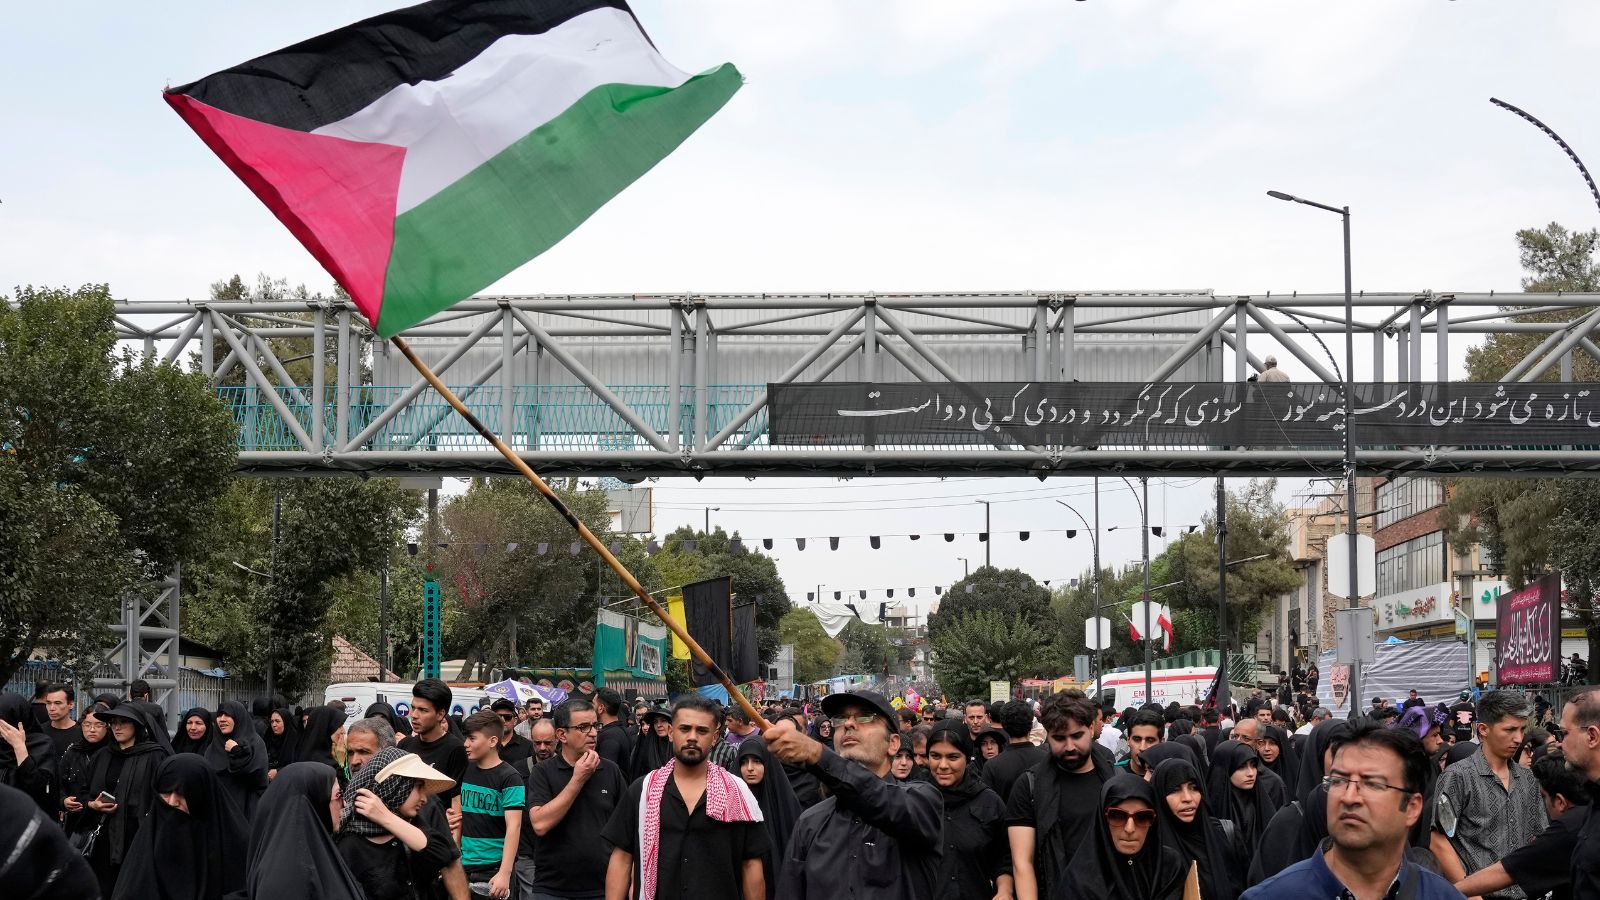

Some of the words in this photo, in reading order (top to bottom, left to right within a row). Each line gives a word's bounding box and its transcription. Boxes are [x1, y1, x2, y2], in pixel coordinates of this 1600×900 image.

[1001, 383, 1030, 421] که
[1025, 398, 1076, 426] دردی
[1081, 409, 1091, 425] و
[1101, 383, 1154, 427] نگردد
[1145, 384, 1173, 441] کم
[1164, 384, 1196, 424] که
[1184, 397, 1242, 427] سوزی
[1396, 399, 1427, 418] درد
[1430, 396, 1467, 427] این
[1545, 390, 1590, 420] تازه
[461, 789, 500, 812] OTTEGA
